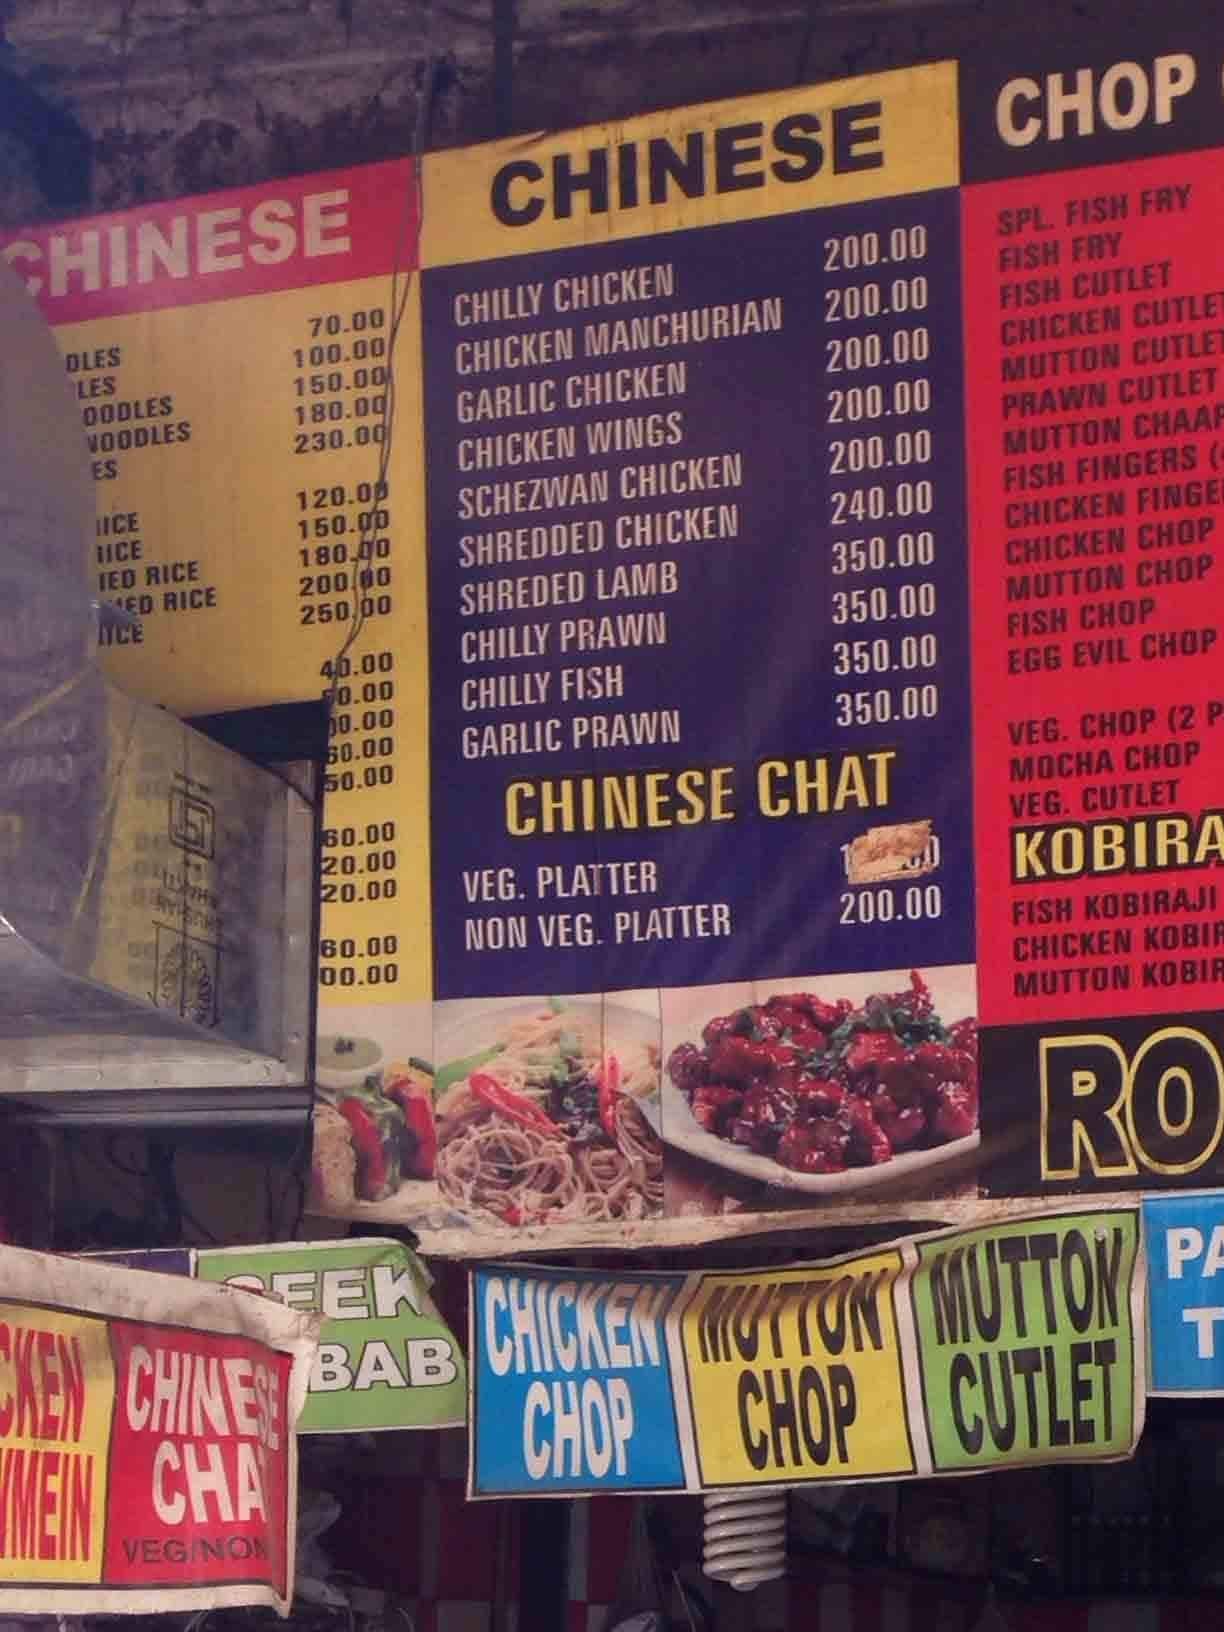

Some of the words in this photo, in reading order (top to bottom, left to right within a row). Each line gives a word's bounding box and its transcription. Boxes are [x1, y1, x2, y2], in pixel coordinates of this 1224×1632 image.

[997, 54, 1195, 146] CHOP
[491, 101, 883, 226] CHINESE
[996, 207, 1053, 236] SPL.
[1067, 194, 1128, 225] FISH
[1141, 184, 1190, 216] FRY
[4, 190, 350, 297] CHINESE
[455, 283, 543, 326] CHILLY
[554, 264, 672, 312] CHICKEN
[824, 225, 926, 271] 200.00
[308, 308, 384, 338] 70.00
[456, 328, 572, 374] CHICKEN
[585, 298, 781, 356] MANCHURIAN
[1001, 307, 1120, 347] CHICKEN
[294, 338, 385, 368] 100.00
[83, 396, 173, 426] OODLES
[1002, 383, 1107, 418] PRAWN
[1119, 368, 1216, 405] CUTLET
[587, 412, 682, 454] WINGS
[1004, 417, 1121, 454] MUTTON
[459, 471, 608, 519] SCHEZWAN
[621, 454, 741, 498] CHICKEN
[1004, 461, 1064, 491] FISH
[1077, 444, 1197, 483] FINGERS
[459, 520, 603, 567] SHREDDED
[832, 481, 932, 524] 240.00
[145, 561, 198, 586] RICE
[461, 571, 584, 615] SHREDED
[597, 562, 677, 600] LAMB
[462, 624, 549, 663] CHILLY
[561, 612, 665, 652] PRAWN
[1008, 645, 1061, 674] EGG
[1074, 638, 1128, 666] EVIL
[1142, 628, 1216, 659] CHOP
[463, 720, 561, 759] GARLIC
[573, 710, 679, 748] PRAWN
[1008, 718, 1066, 745] VEG.
[1081, 708, 1156, 739] CHOP
[1168, 705, 1195, 732] (2
[1011, 749, 1114, 781] MOCHA
[1125, 741, 1200, 771] CHOP
[506, 768, 734, 835] CHINESE
[758, 752, 895, 816] CHAT
[463, 868, 524, 902] VEG.
[538, 862, 656, 898] PLATTER
[466, 917, 526, 950] NON
[538, 914, 602, 946] VEG.
[616, 904, 730, 943] PLATTER
[840, 886, 940, 924] 200.00
[1014, 928, 1131, 961] CHICKEN
[931, 1227, 1122, 1344] MUTTON
[485, 1278, 672, 1376] CHICKEN
[702, 1269, 888, 1363] MUTTON
[127, 1345, 278, 1450] CHINESE
[738, 1365, 856, 1470] CHOP
[950, 1338, 1116, 1456] CUTLET
[524, 1379, 633, 1479] CHOP
[154, 1441, 267, 1525] CHA
